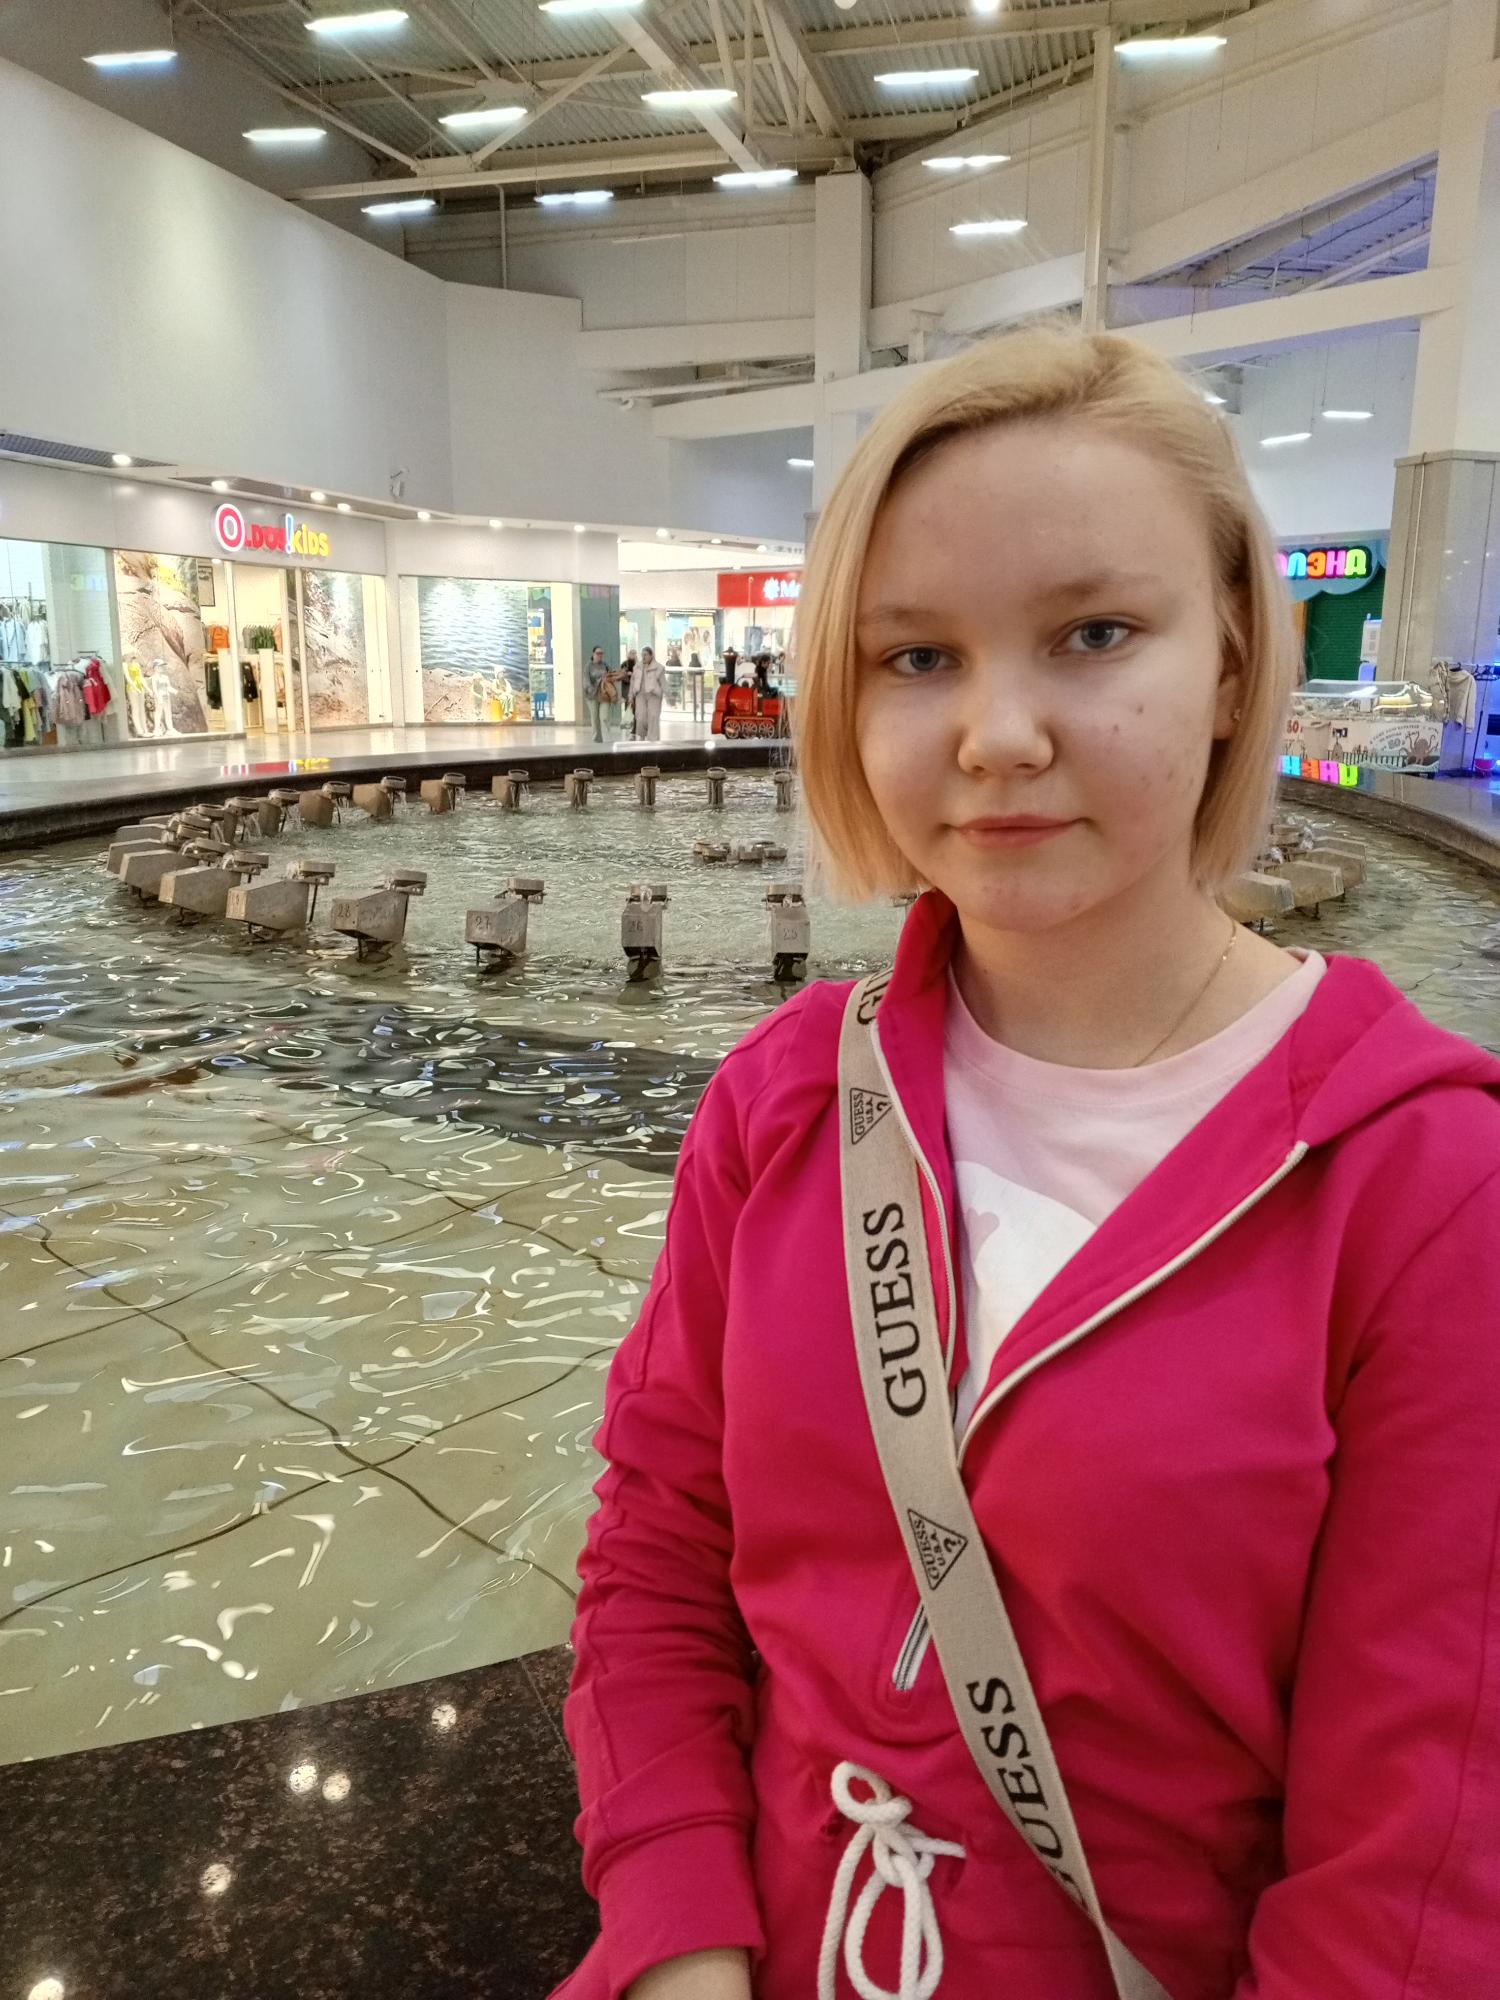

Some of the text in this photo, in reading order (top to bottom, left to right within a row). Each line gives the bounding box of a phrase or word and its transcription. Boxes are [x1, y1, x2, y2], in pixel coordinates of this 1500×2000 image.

[853, 1092, 866, 1136] GUESS
[862, 1202, 928, 1418] GUESS
[914, 1519, 940, 1580] GUESS
[943, 1537, 962, 1554] ?
